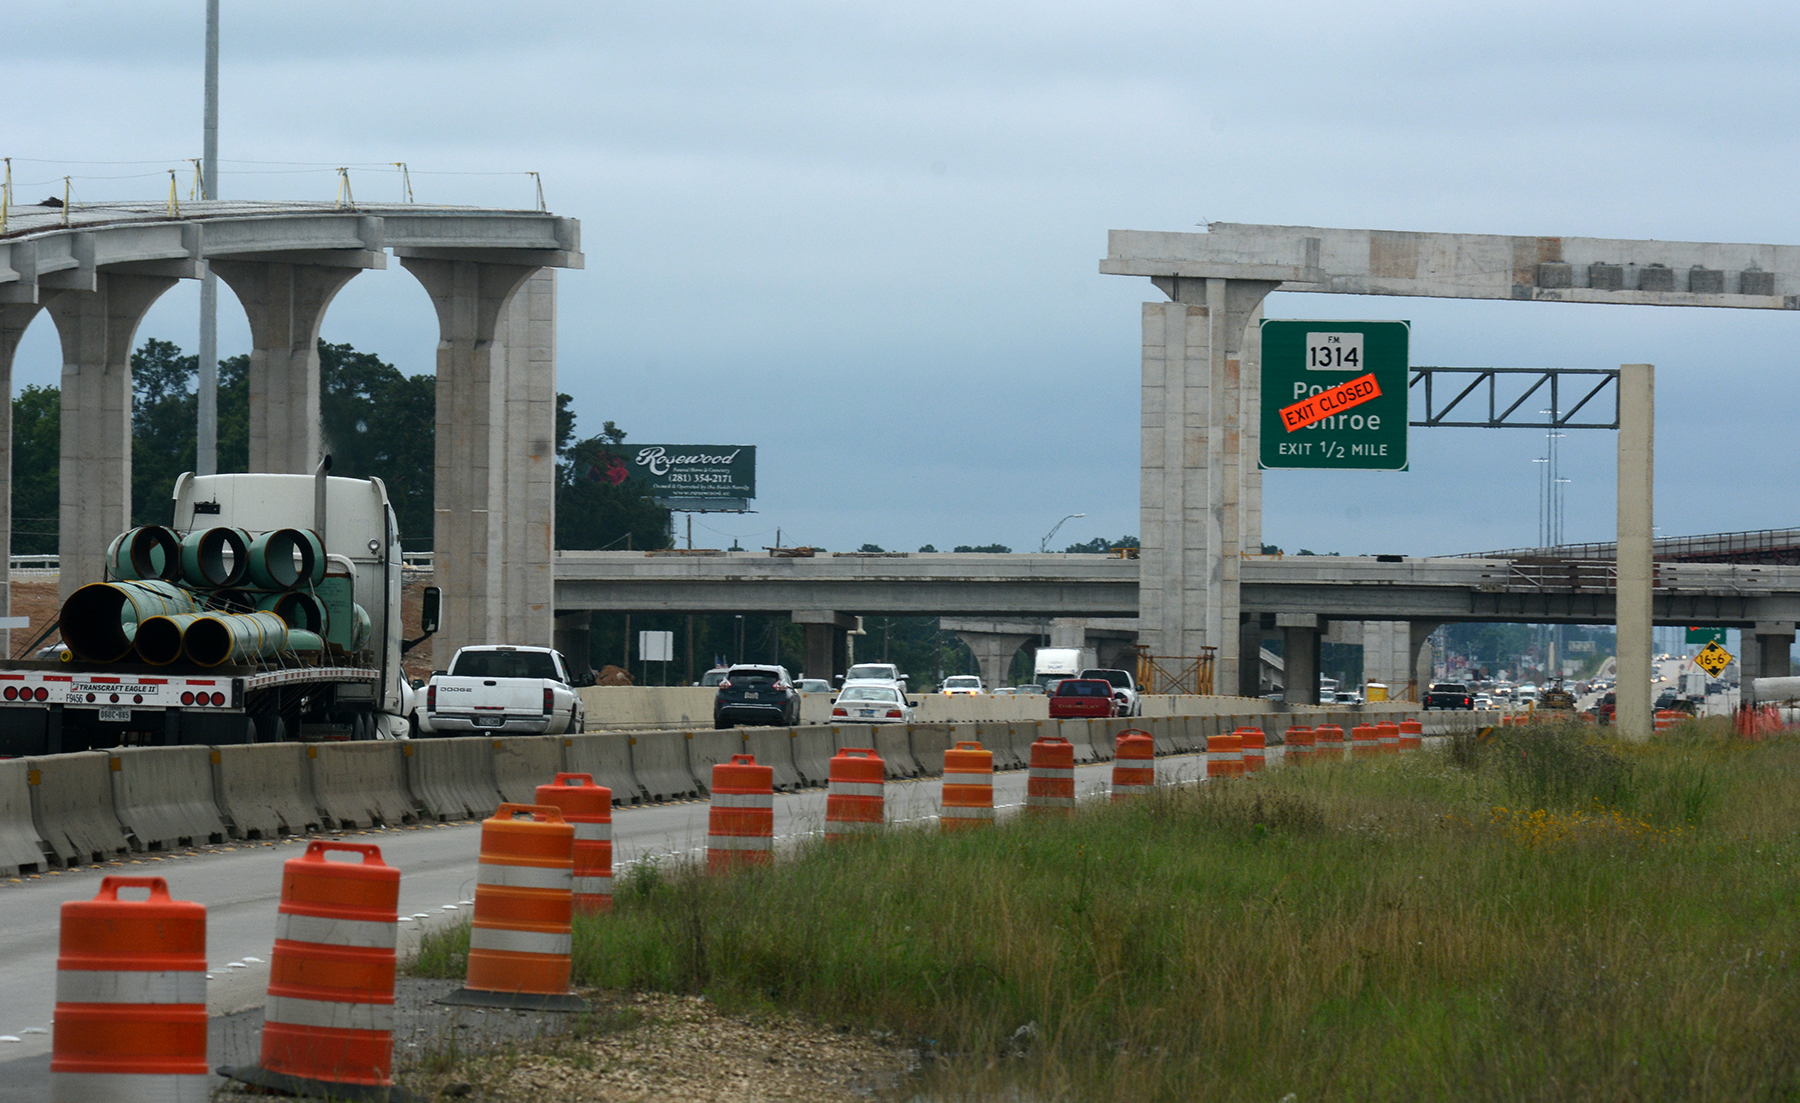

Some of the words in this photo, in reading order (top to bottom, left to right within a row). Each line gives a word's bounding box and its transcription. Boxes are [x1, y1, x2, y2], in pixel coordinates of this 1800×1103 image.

[1310, 346, 1359, 367] 1314
[1285, 403, 1315, 426] EXIT
[1319, 380, 1374, 412] CLOSED
[1279, 443, 1312, 455] EXIT
[1319, 441, 1345, 458] 1/2
[1352, 444, 1387, 456] MILE
[635, 446, 741, 476] Rosewood
[668, 473, 692, 482] (281)
[693, 474, 733, 483] 354-2171
[79, 684, 124, 692] TRANSCRAFT
[125, 685, 147, 693] EAGLE
